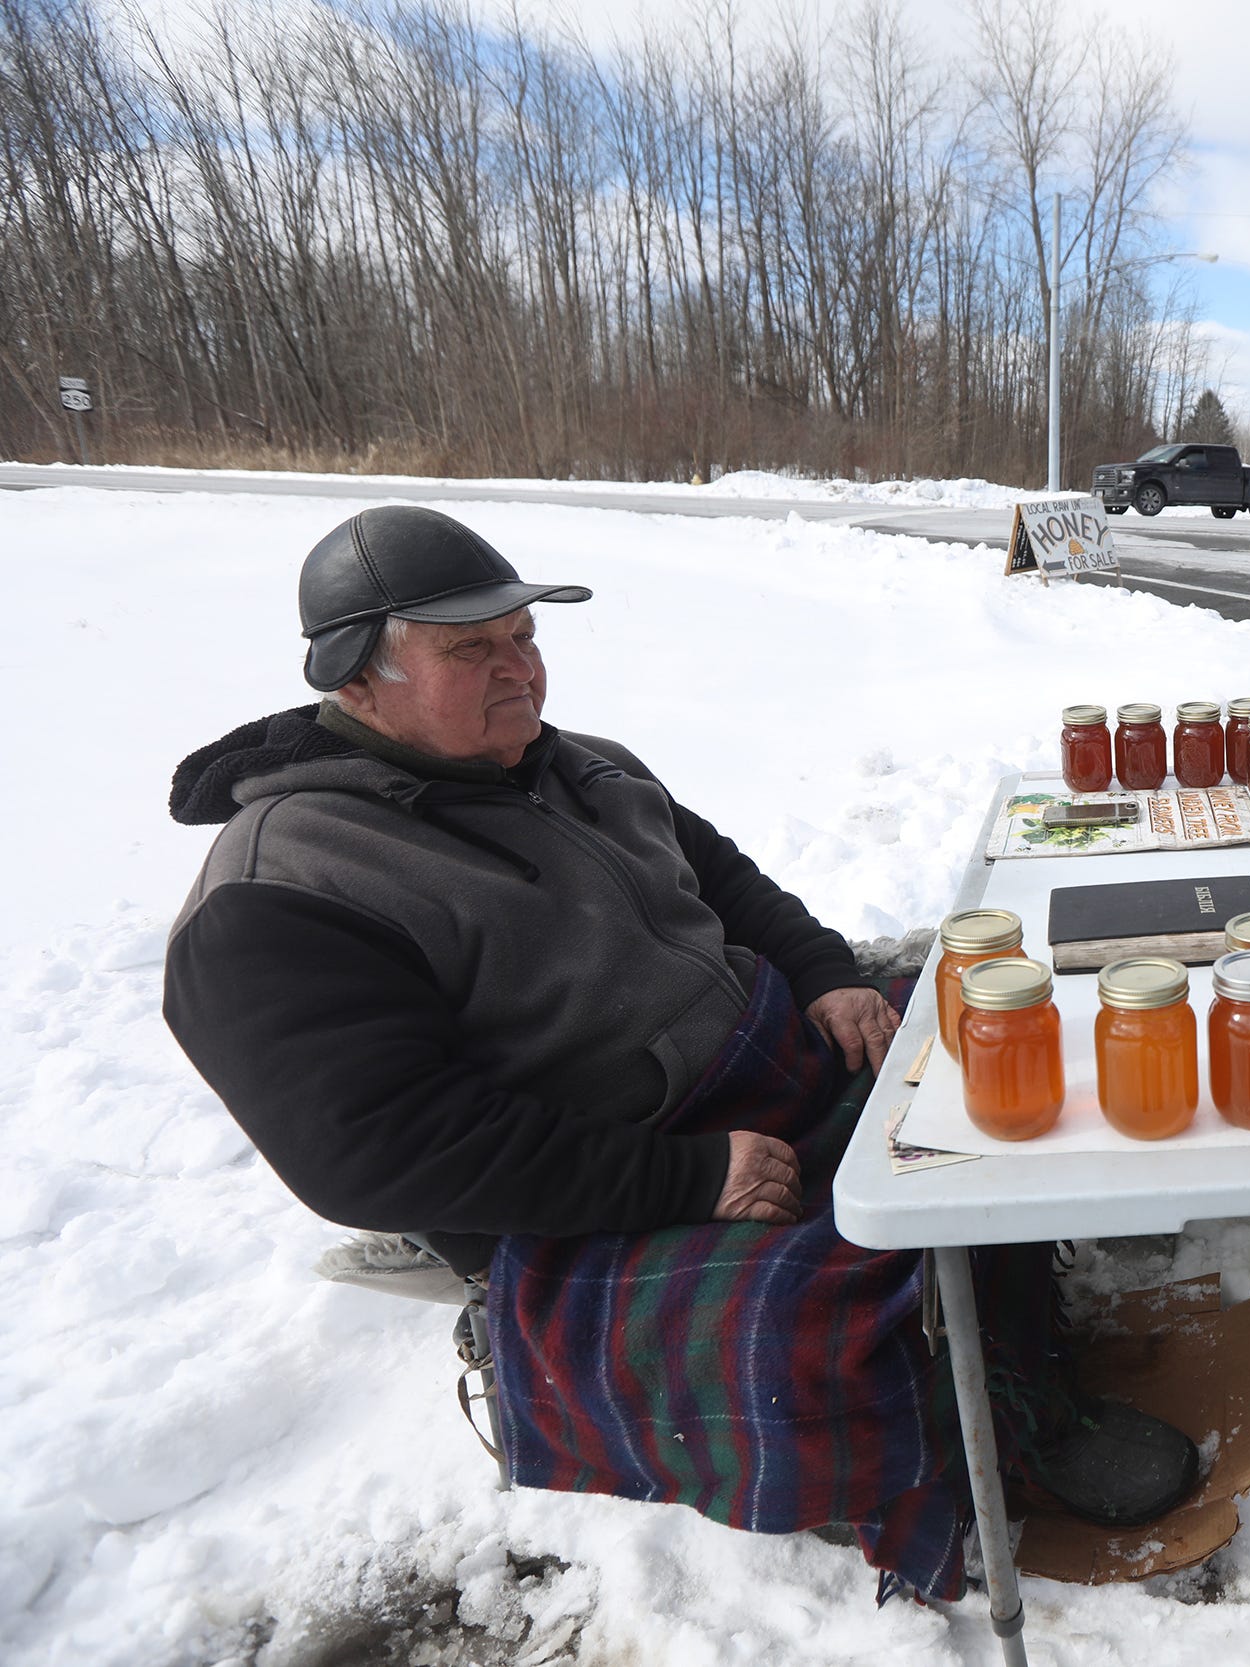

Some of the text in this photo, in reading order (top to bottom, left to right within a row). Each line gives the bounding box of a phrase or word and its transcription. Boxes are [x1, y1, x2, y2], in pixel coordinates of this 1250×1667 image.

[63, 393, 90, 407] 250
[1026, 502, 1052, 515] LOCAL
[1053, 500, 1070, 512] RAW
[1031, 512, 1109, 554] HONEY
[1067, 551, 1116, 571] FOR SALE
[1151, 797, 1176, 835] FLOWERS
[1179, 791, 1210, 840] LINDEN TREE
[1209, 790, 1243, 836] HONEY FROM
[1195, 887, 1216, 913] БІБЛІЯ
